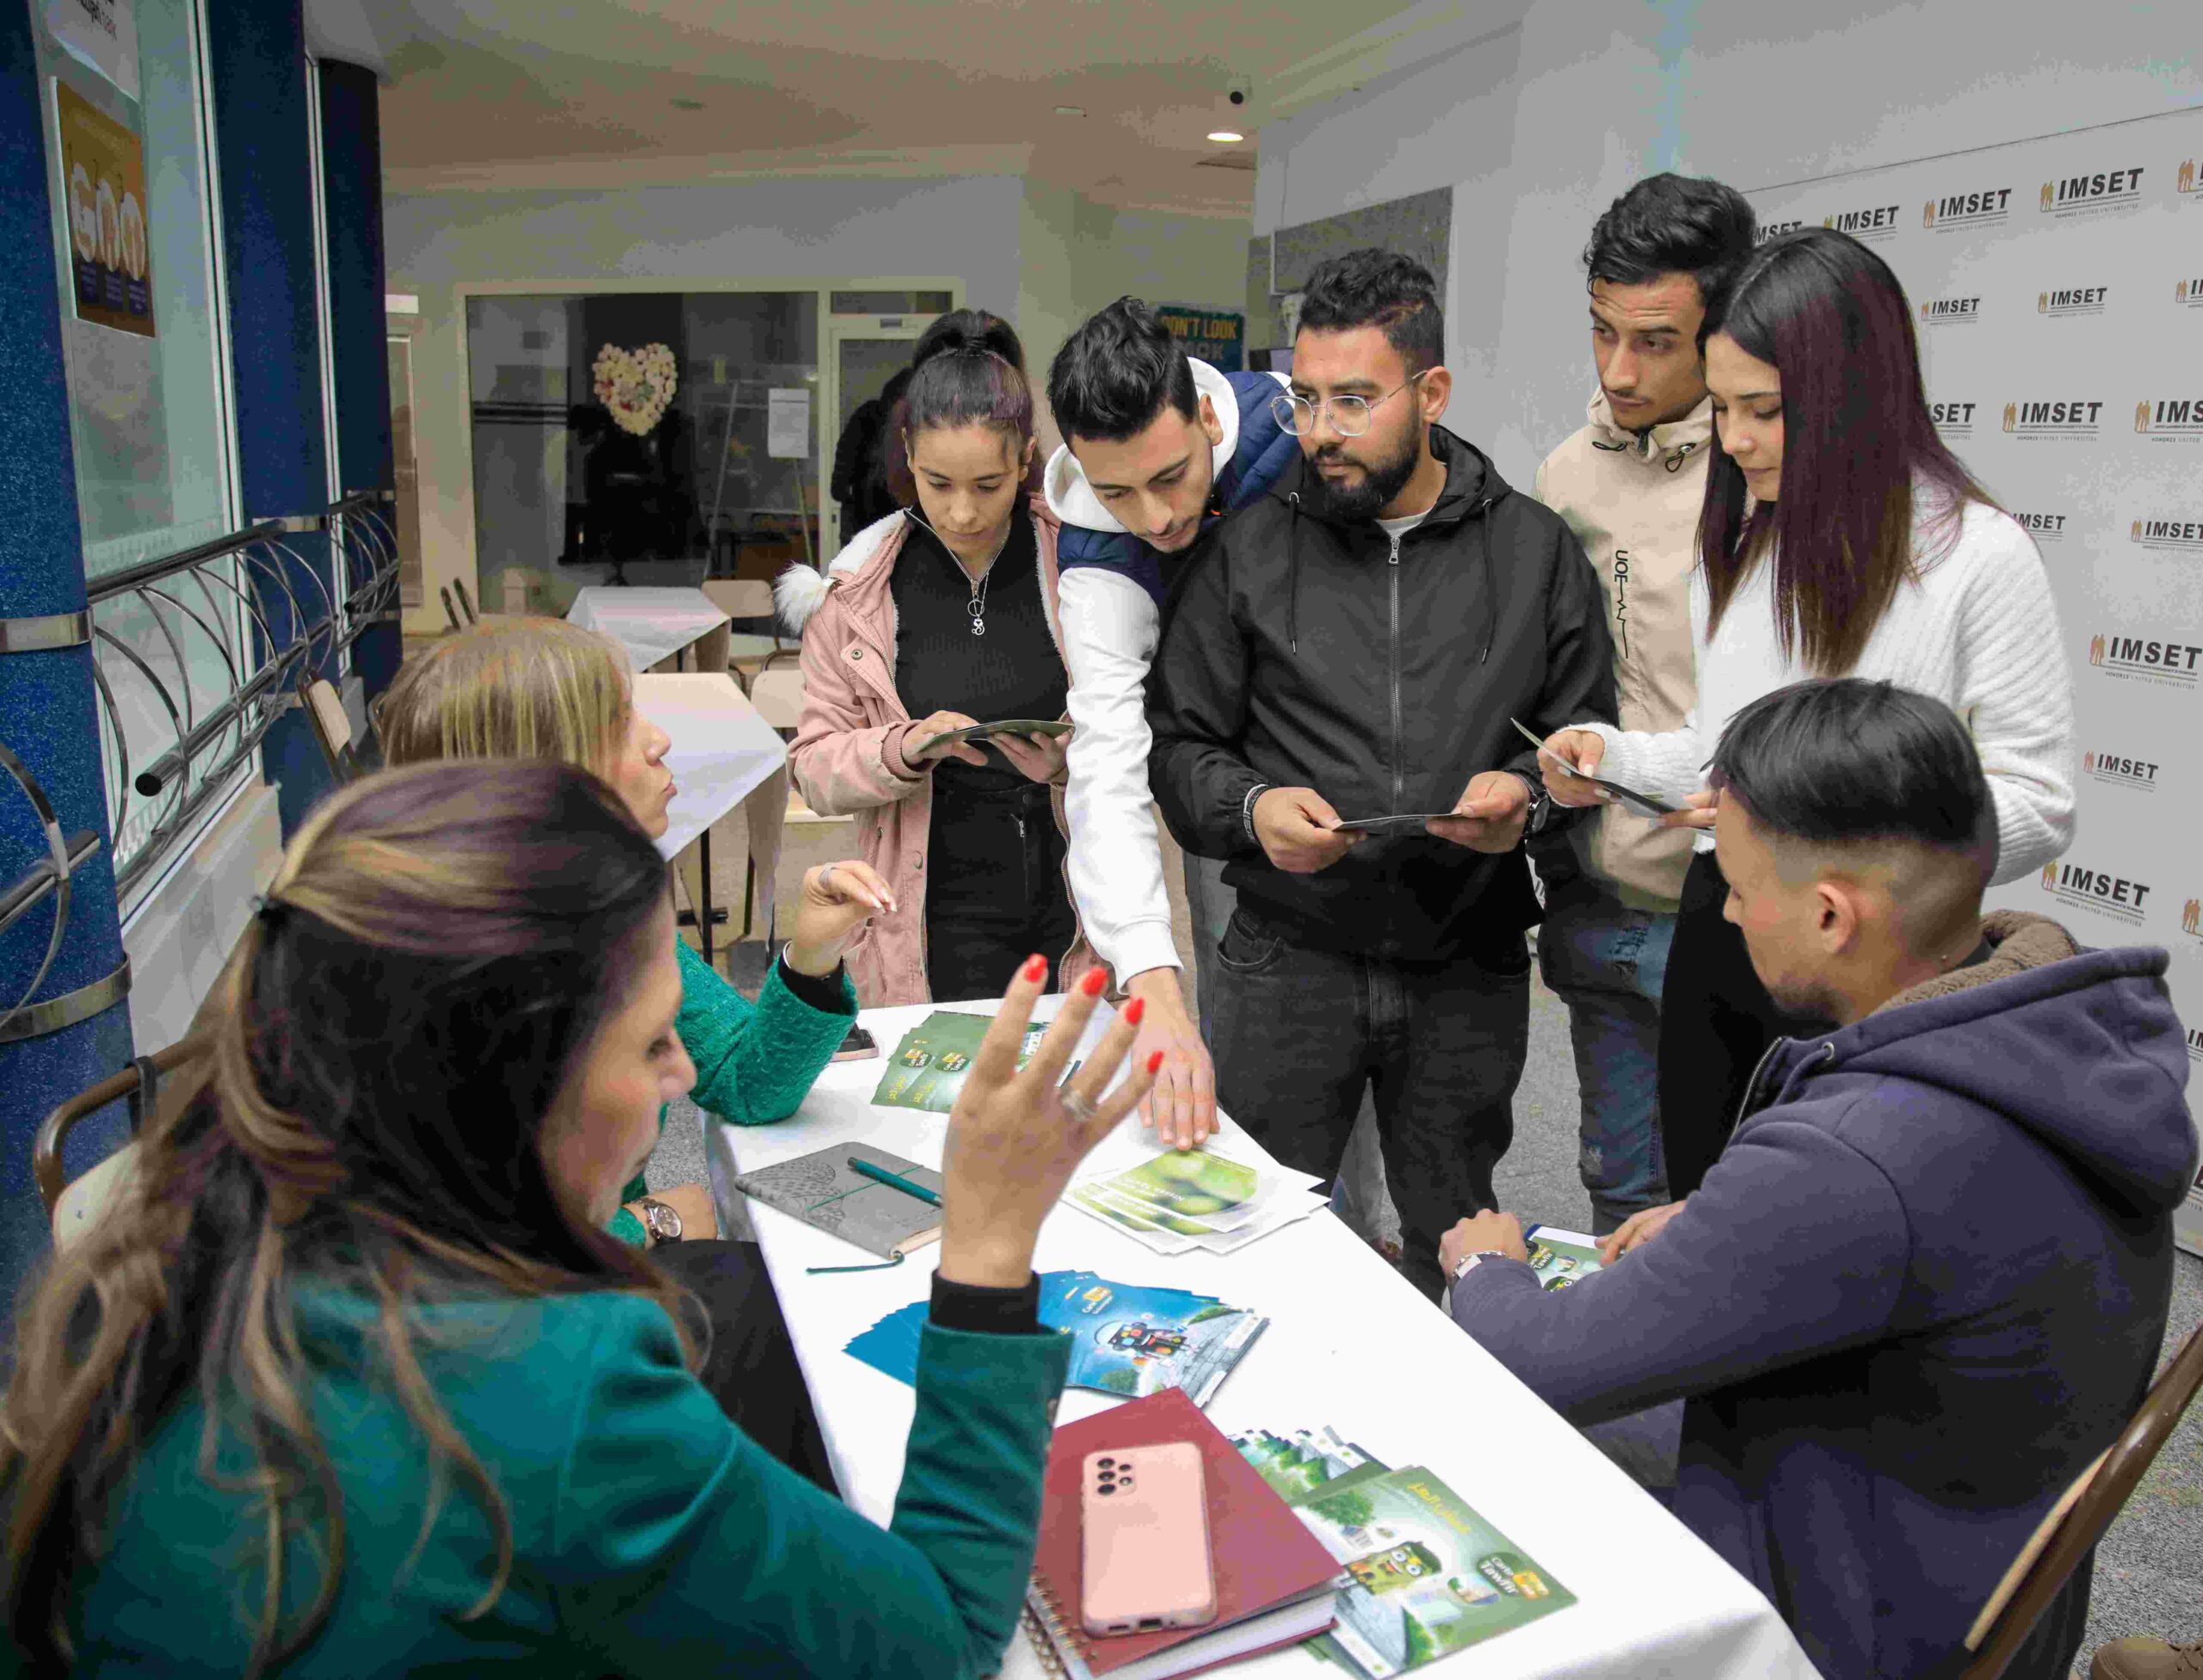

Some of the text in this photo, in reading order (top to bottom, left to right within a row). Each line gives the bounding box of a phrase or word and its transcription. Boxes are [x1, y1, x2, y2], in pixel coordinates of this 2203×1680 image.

[2058, 168, 2144, 201] IMSET
[1939, 188, 2012, 218] IMSET
[1836, 206, 1900, 232] IMSET
[1755, 220, 1802, 244] MSET
[1932, 298, 1980, 314] IMSET
[2050, 287, 2107, 306] IMSET
[1204, 319, 1237, 340] LOOK
[1932, 403, 1976, 423] SET
[2021, 402, 2103, 423] IMSET
[2110, 637, 2203, 670] IMSET
[2097, 754, 2158, 779] IMSET
[2061, 864, 2151, 906] IMSET
